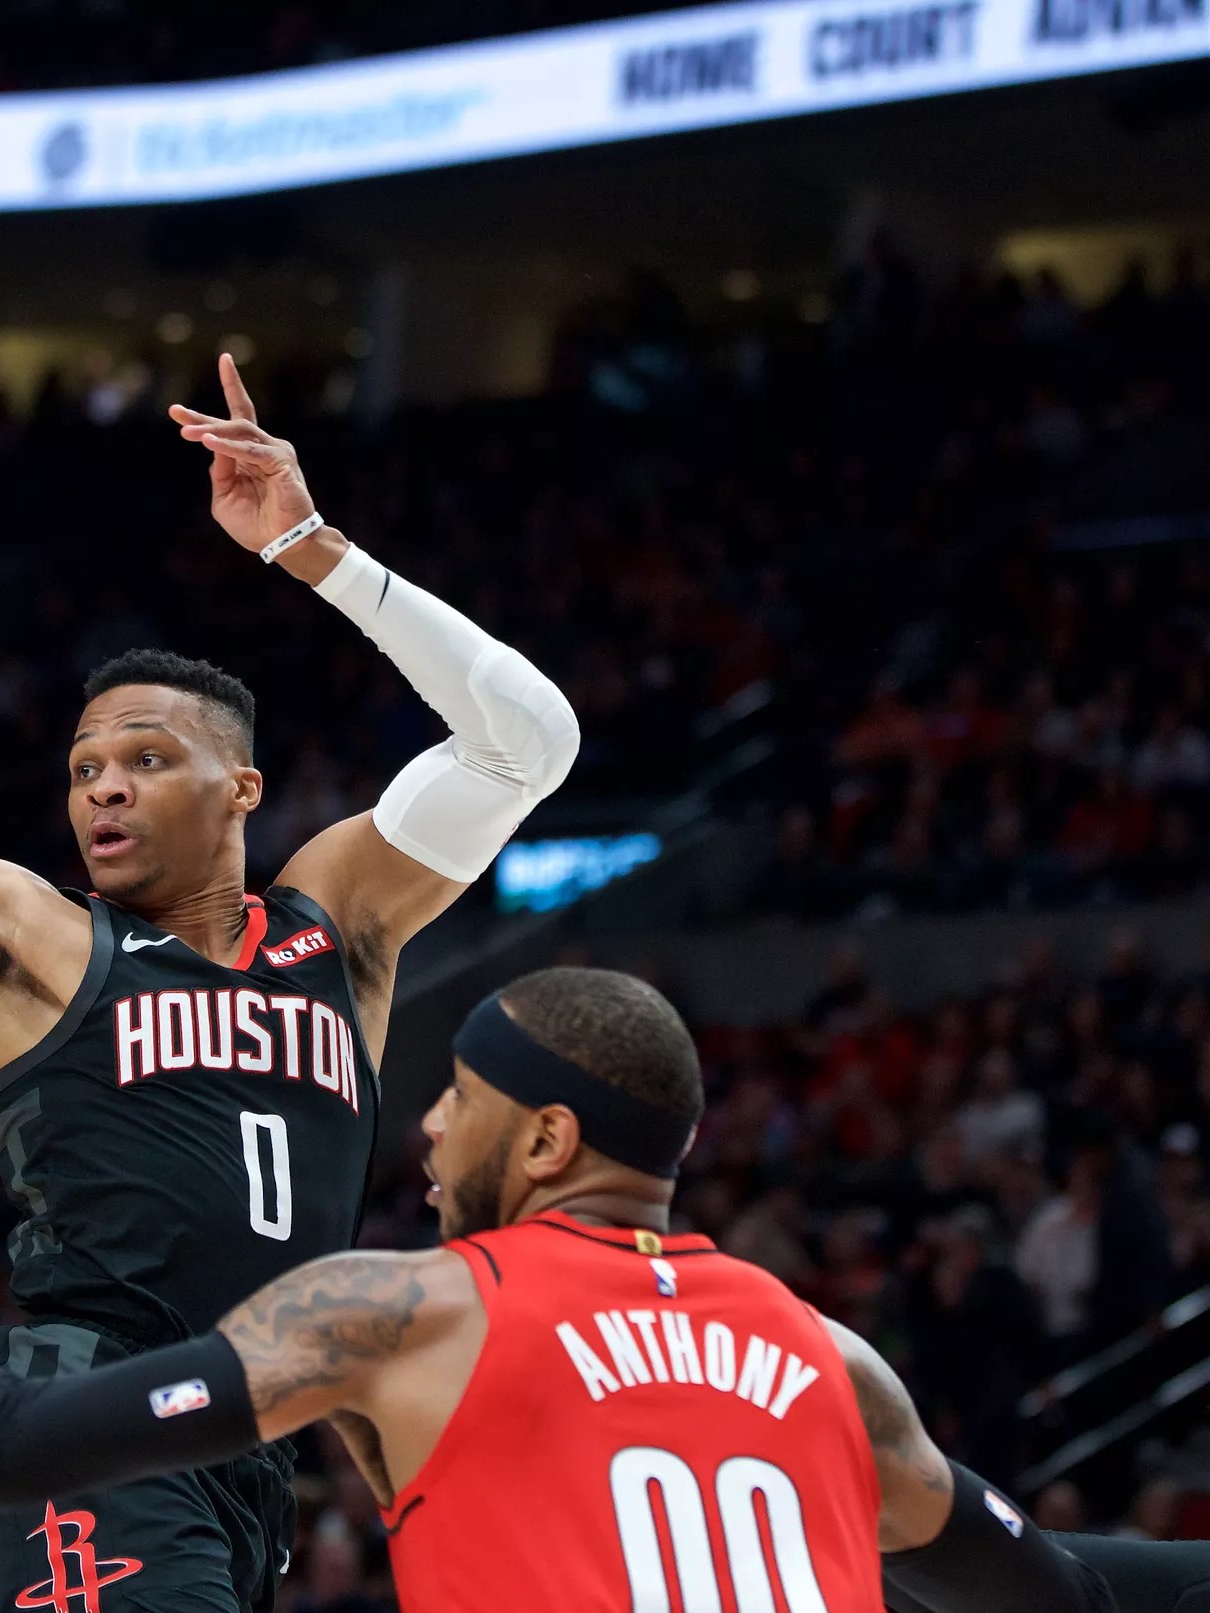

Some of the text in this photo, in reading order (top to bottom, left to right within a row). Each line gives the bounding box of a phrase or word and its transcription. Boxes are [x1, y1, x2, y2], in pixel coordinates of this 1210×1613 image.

[619, 32, 759, 104] HOME
[115, 987, 359, 1117] HOUSTON
[239, 1110, 292, 1241] 0
[555, 1309, 820, 1420] ANTHONY
[609, 1446, 830, 1613] 00
